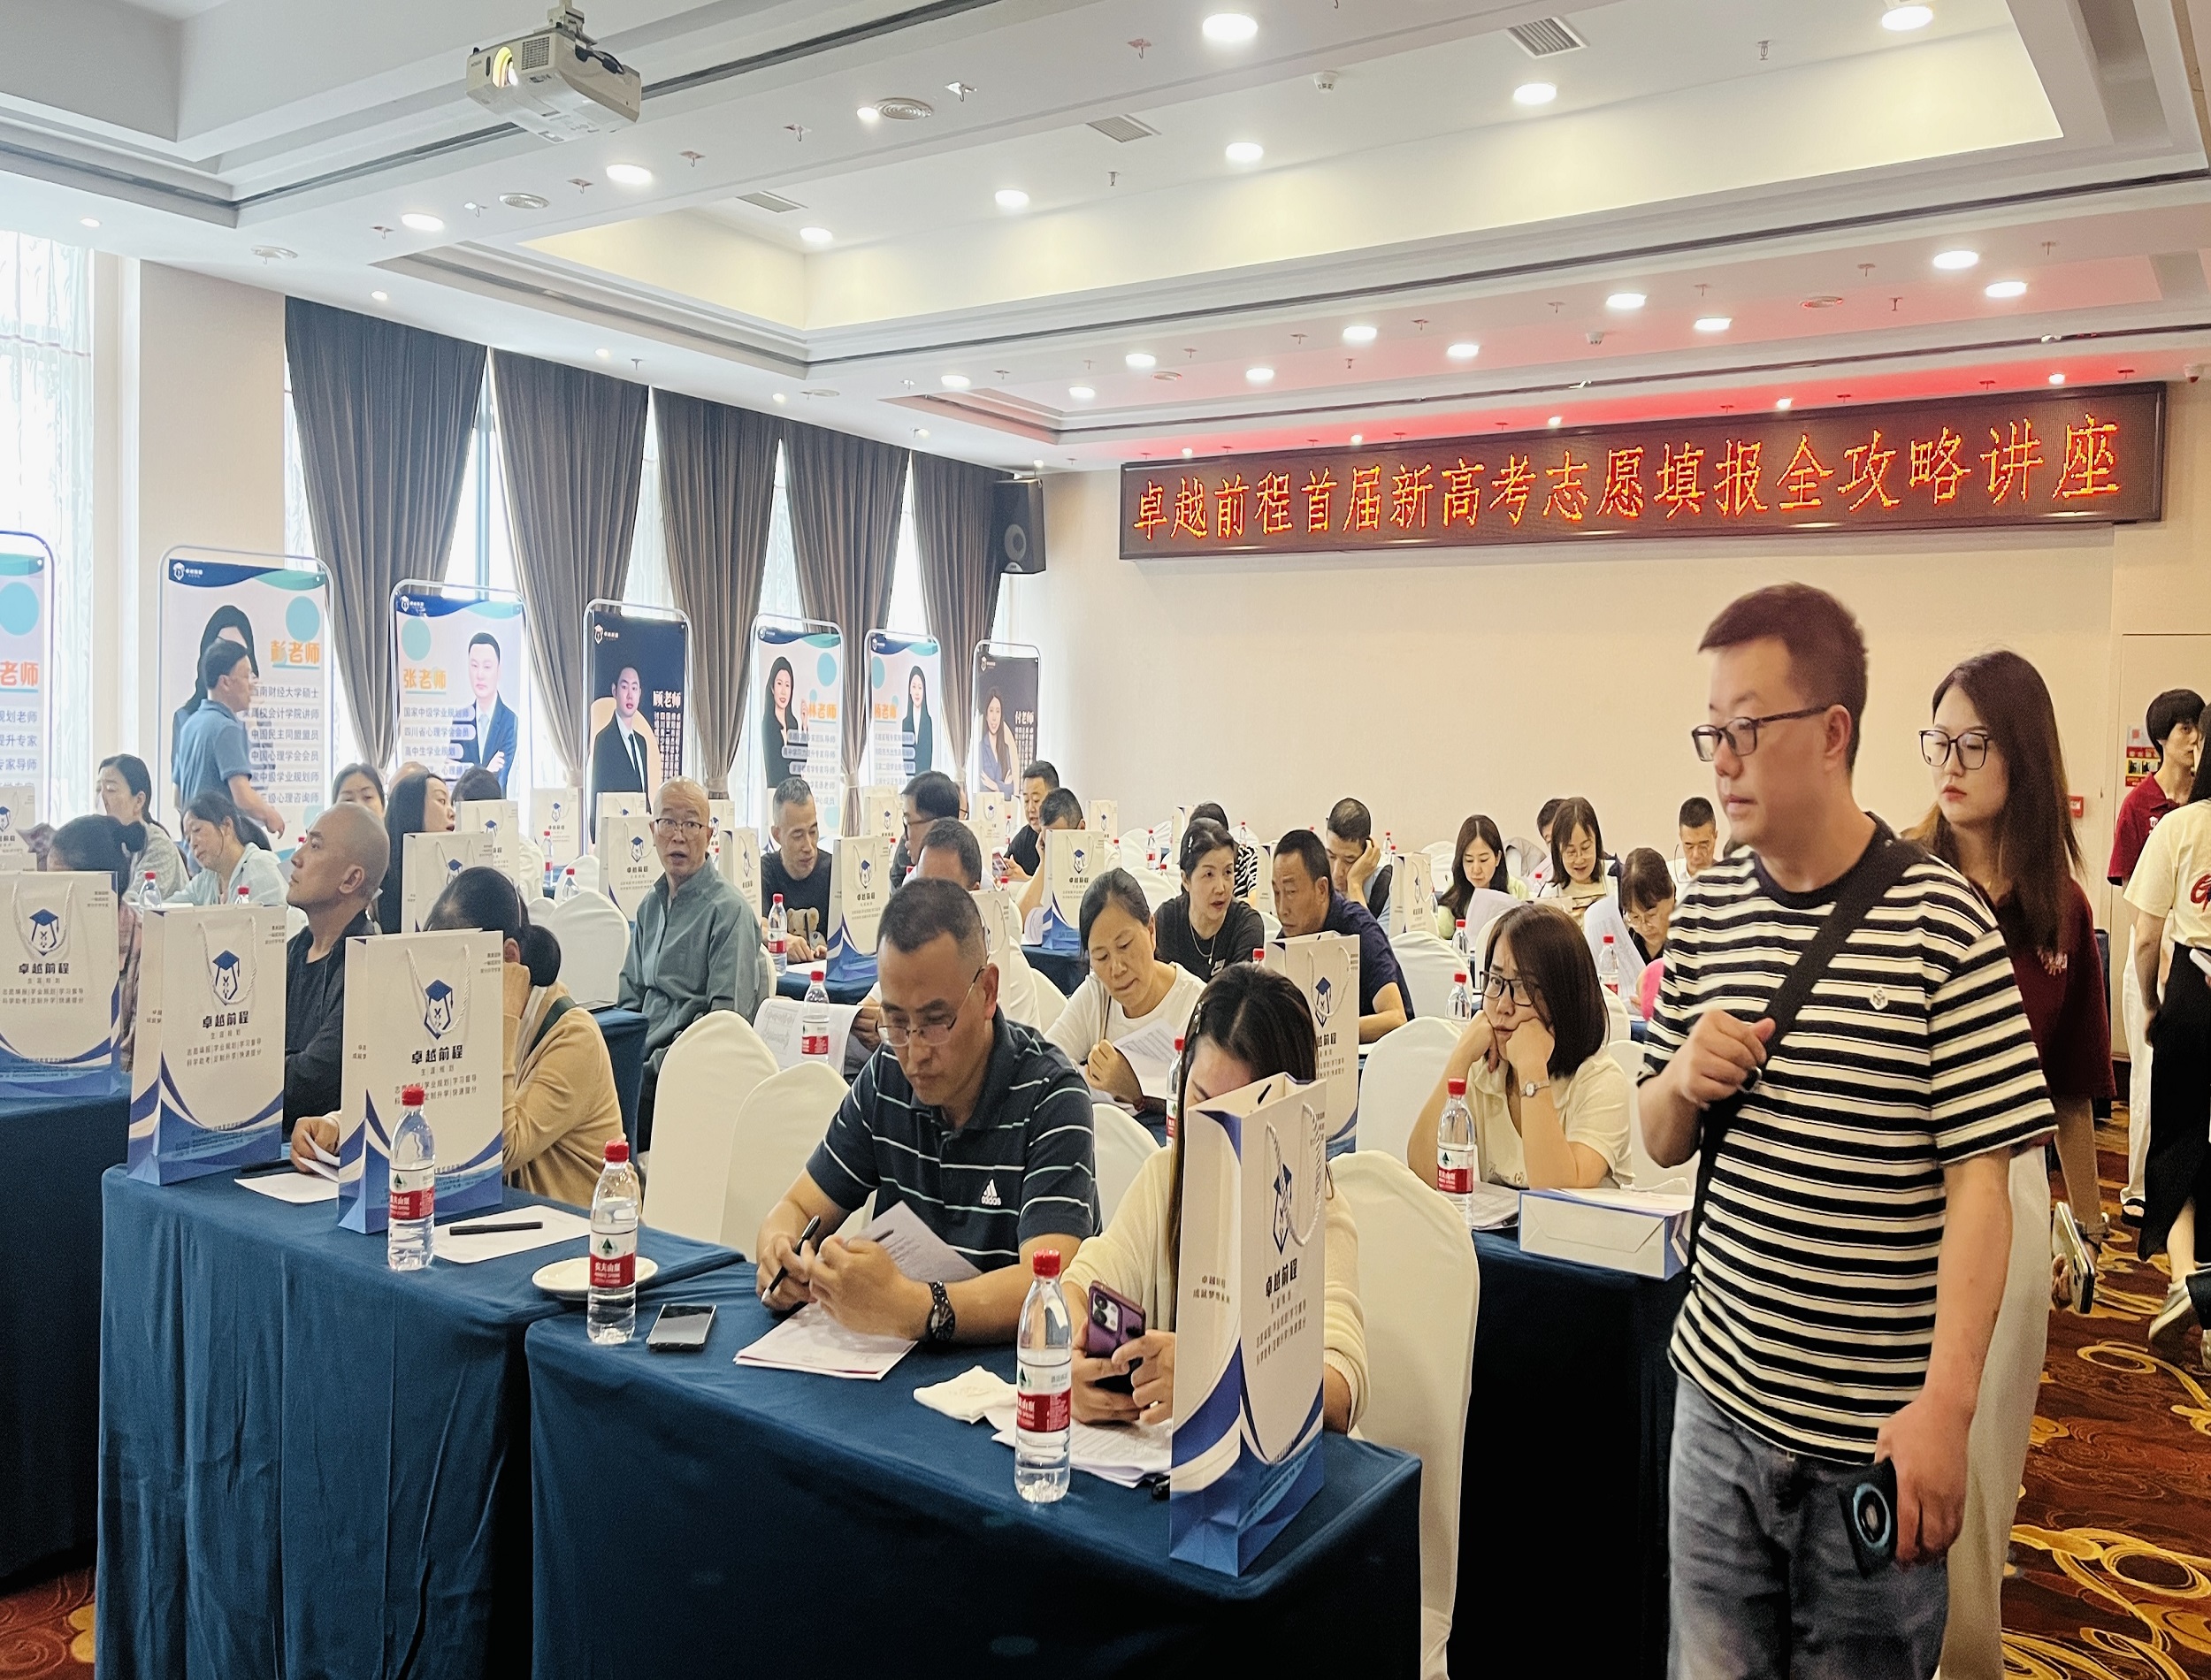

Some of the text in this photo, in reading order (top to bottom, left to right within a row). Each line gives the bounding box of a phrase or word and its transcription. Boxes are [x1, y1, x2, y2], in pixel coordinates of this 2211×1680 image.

[1133, 413, 2120, 540] 卓越前程首届新高考志愿填报全攻略讲座
[271, 640, 320, 665] 彭老师
[0, 661, 39, 687] 老师
[403, 668, 448, 691] 张老师
[19, 962, 70, 974] 卓越前程
[203, 1010, 249, 1028] 卓越前程
[411, 1044, 464, 1065] 卓越前程
[1266, 1257, 1297, 1298] 卓越前程
